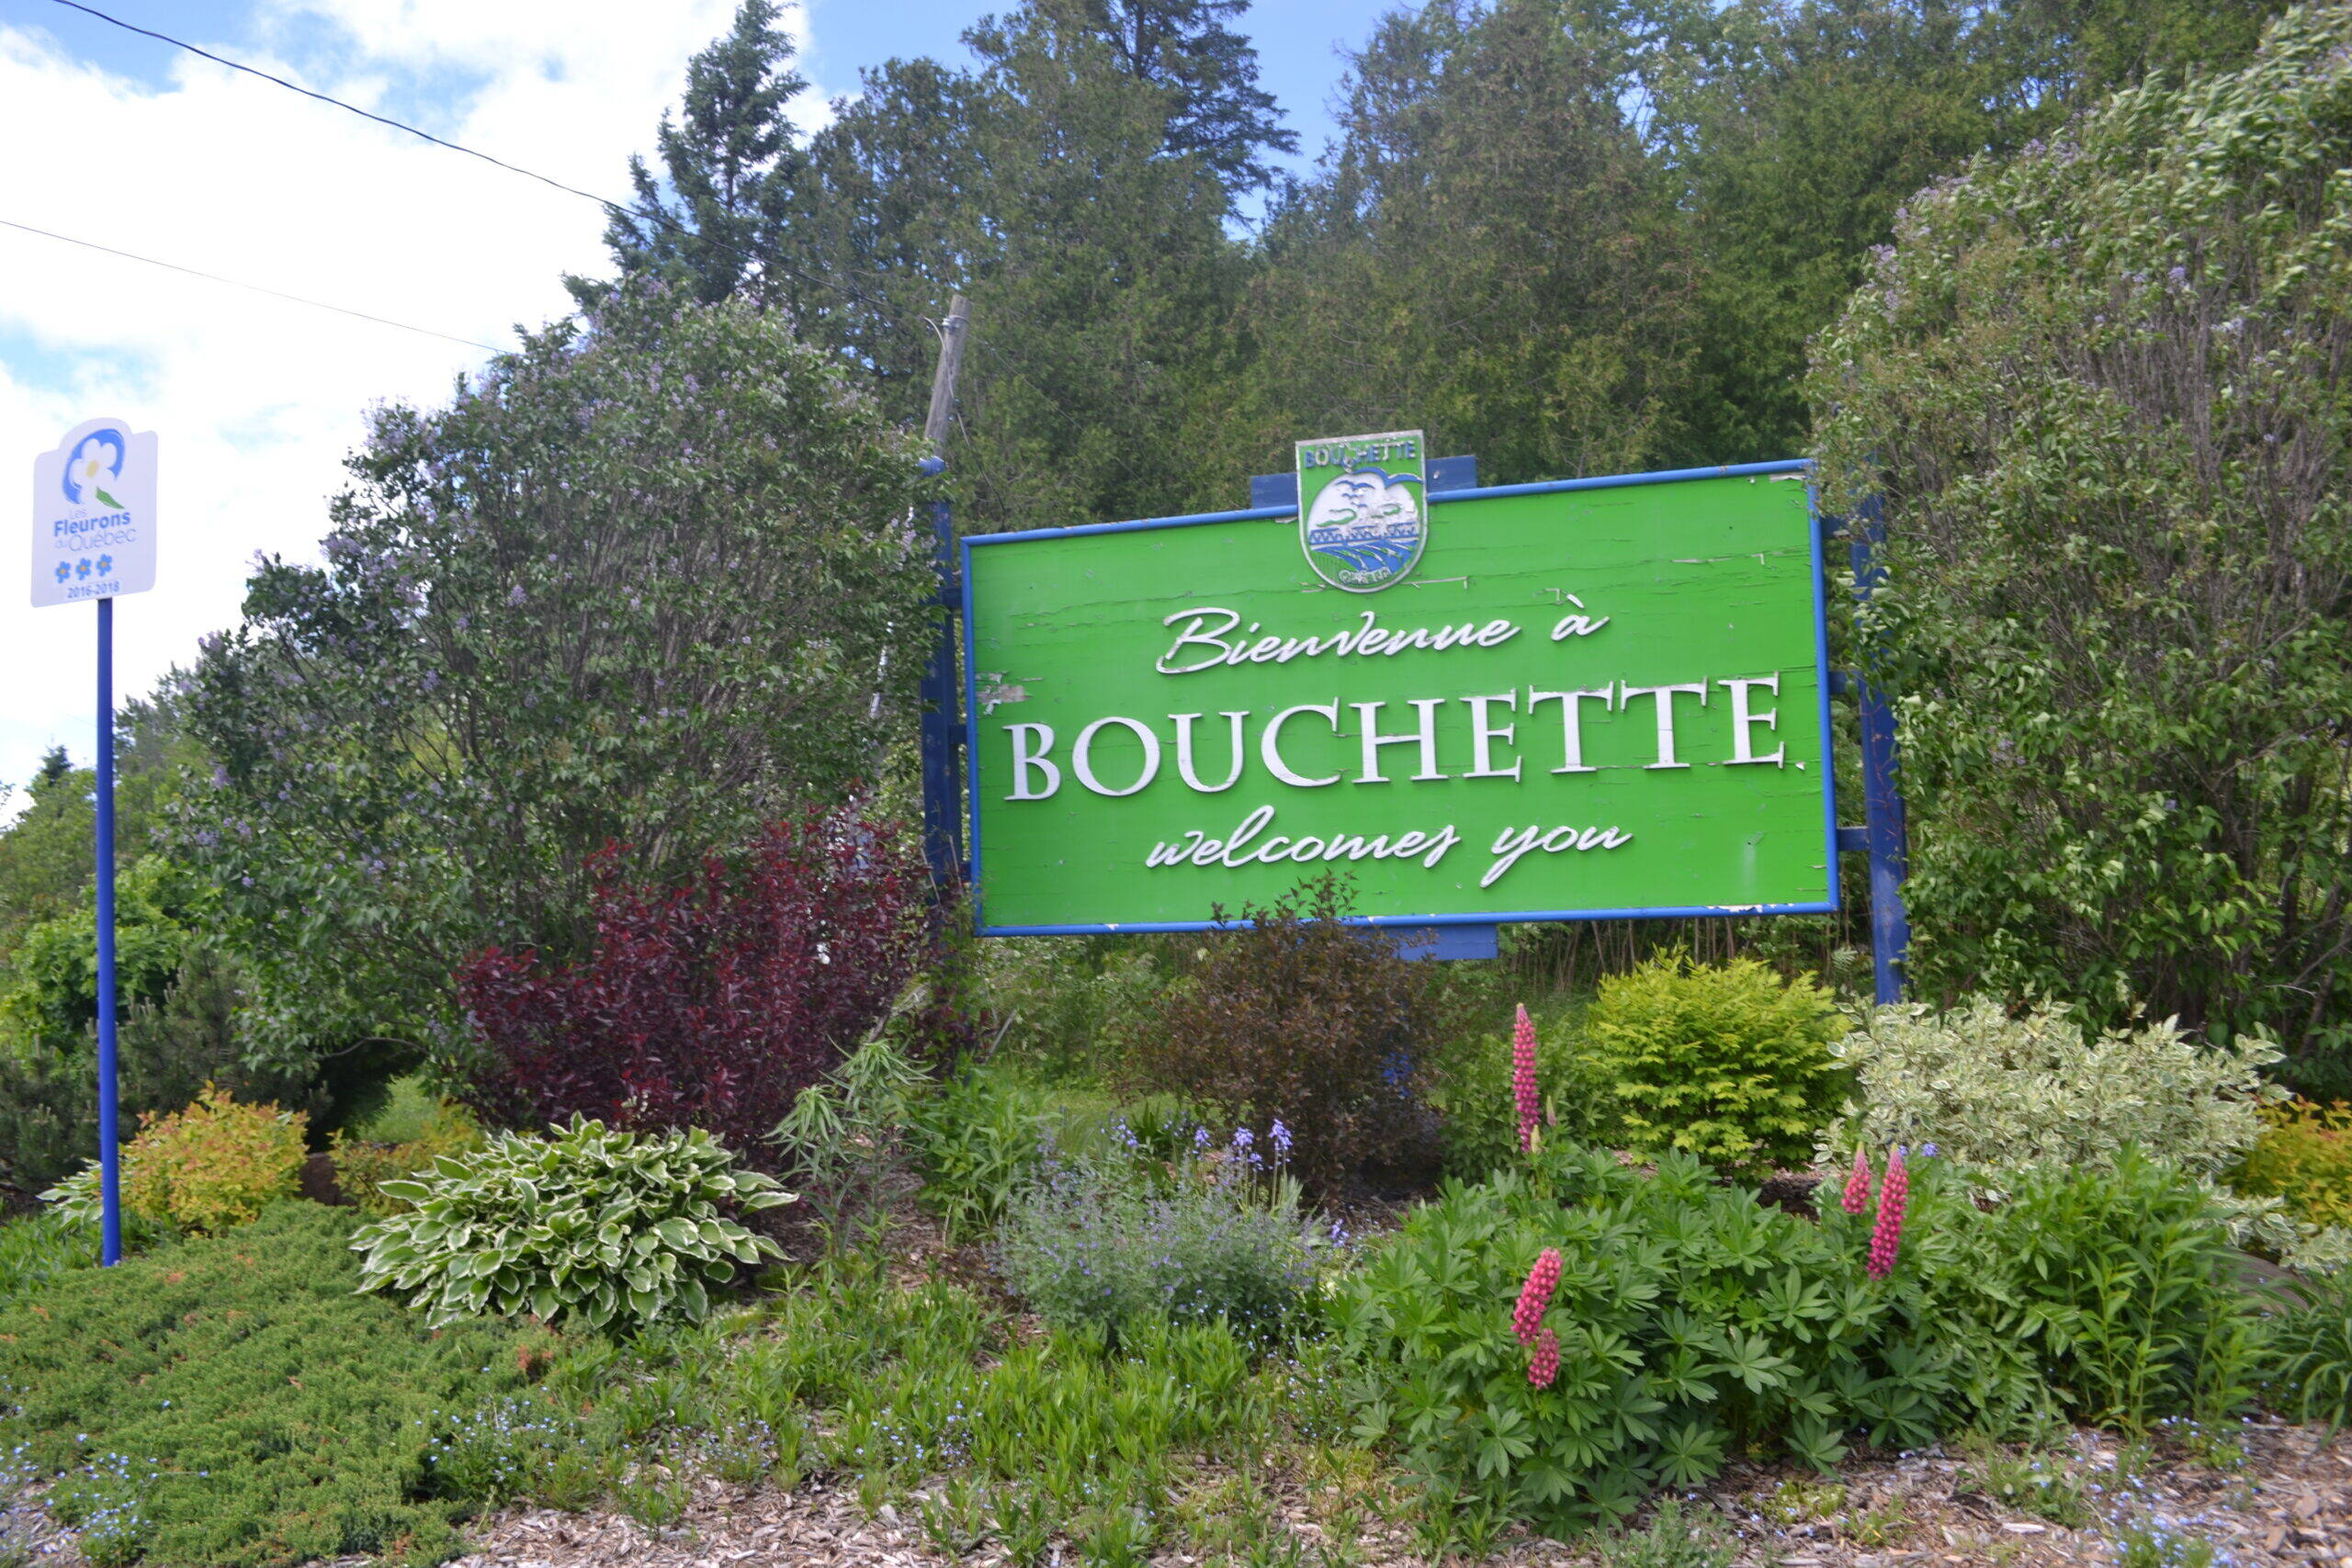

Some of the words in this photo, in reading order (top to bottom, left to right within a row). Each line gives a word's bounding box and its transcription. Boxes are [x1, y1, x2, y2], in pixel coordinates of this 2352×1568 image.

[53, 512, 130, 536] Fleurons
[69, 528, 137, 551] Québec
[1155, 606, 1521, 674] Bienvenue
[1551, 592, 1610, 642] à
[1002, 671, 1785, 802] BOUCHETTE
[1146, 805, 1461, 868] welcomes
[1479, 824, 1632, 889] you
